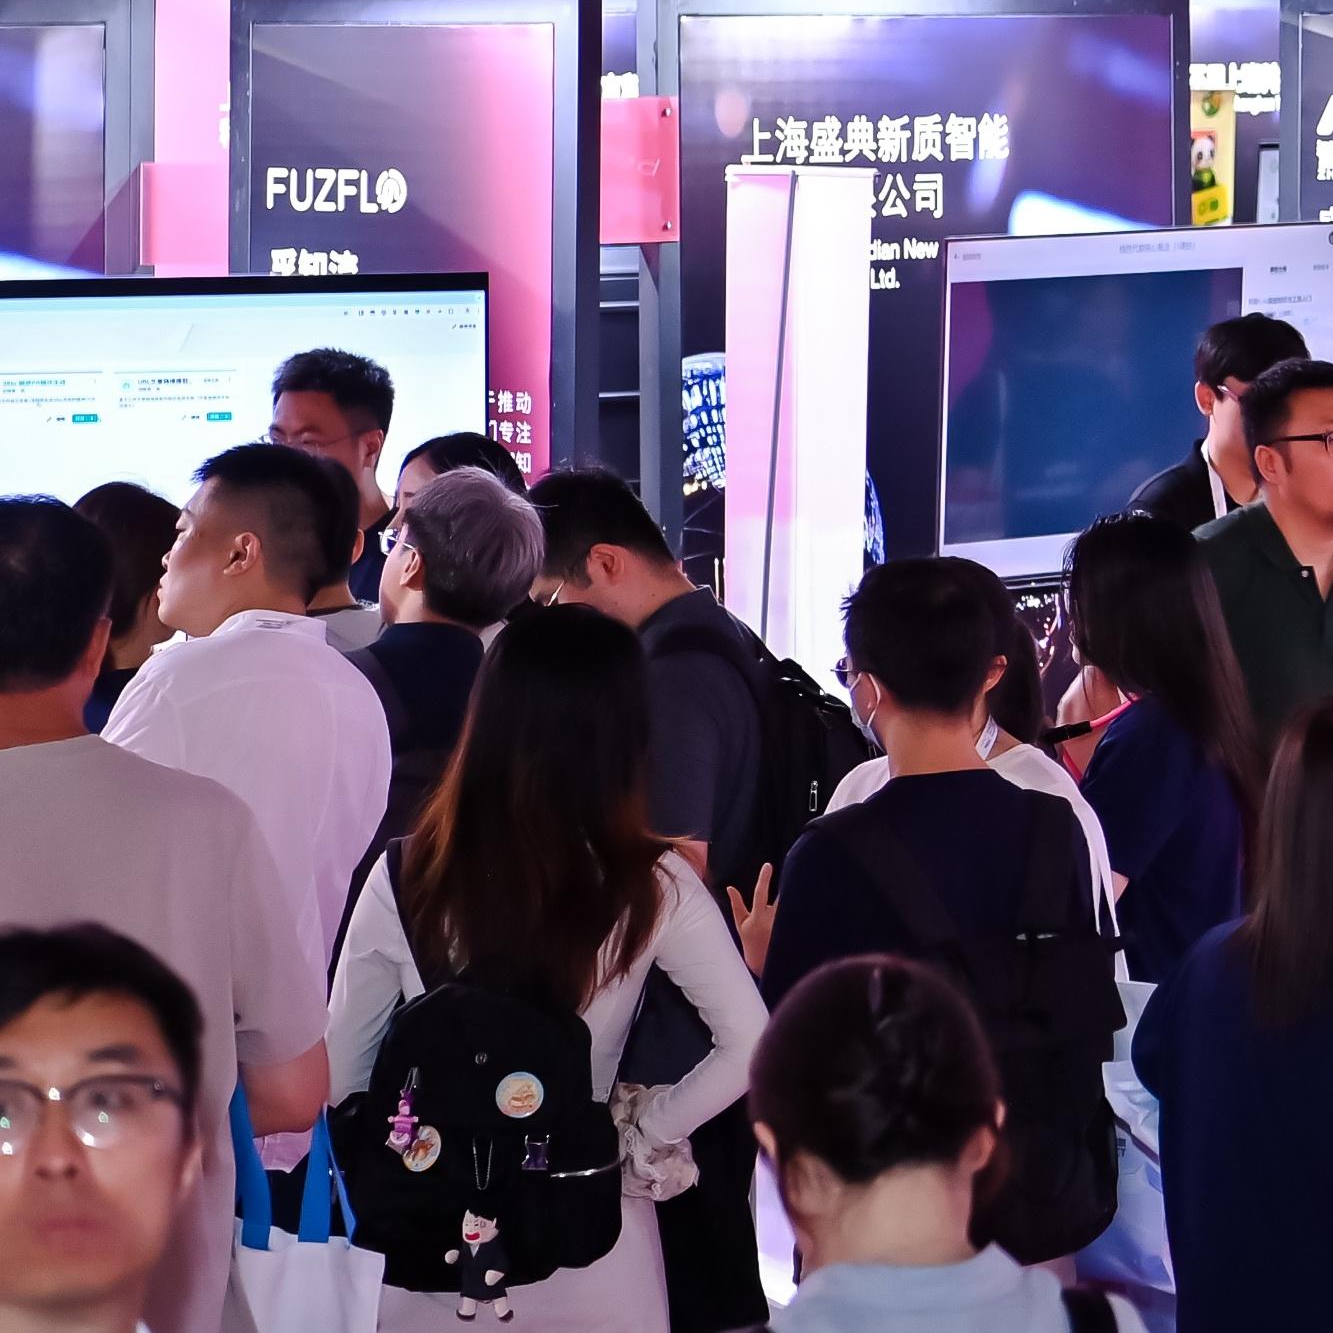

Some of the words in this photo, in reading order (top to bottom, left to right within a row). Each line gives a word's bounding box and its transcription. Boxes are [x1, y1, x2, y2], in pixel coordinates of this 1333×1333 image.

[740, 113, 1010, 164] 上海盛典新质智能
[871, 173, 943, 219] 公司
[869, 238, 900, 261] dian
[904, 237, 939, 259] New
[870, 267, 900, 290] Ltd.
